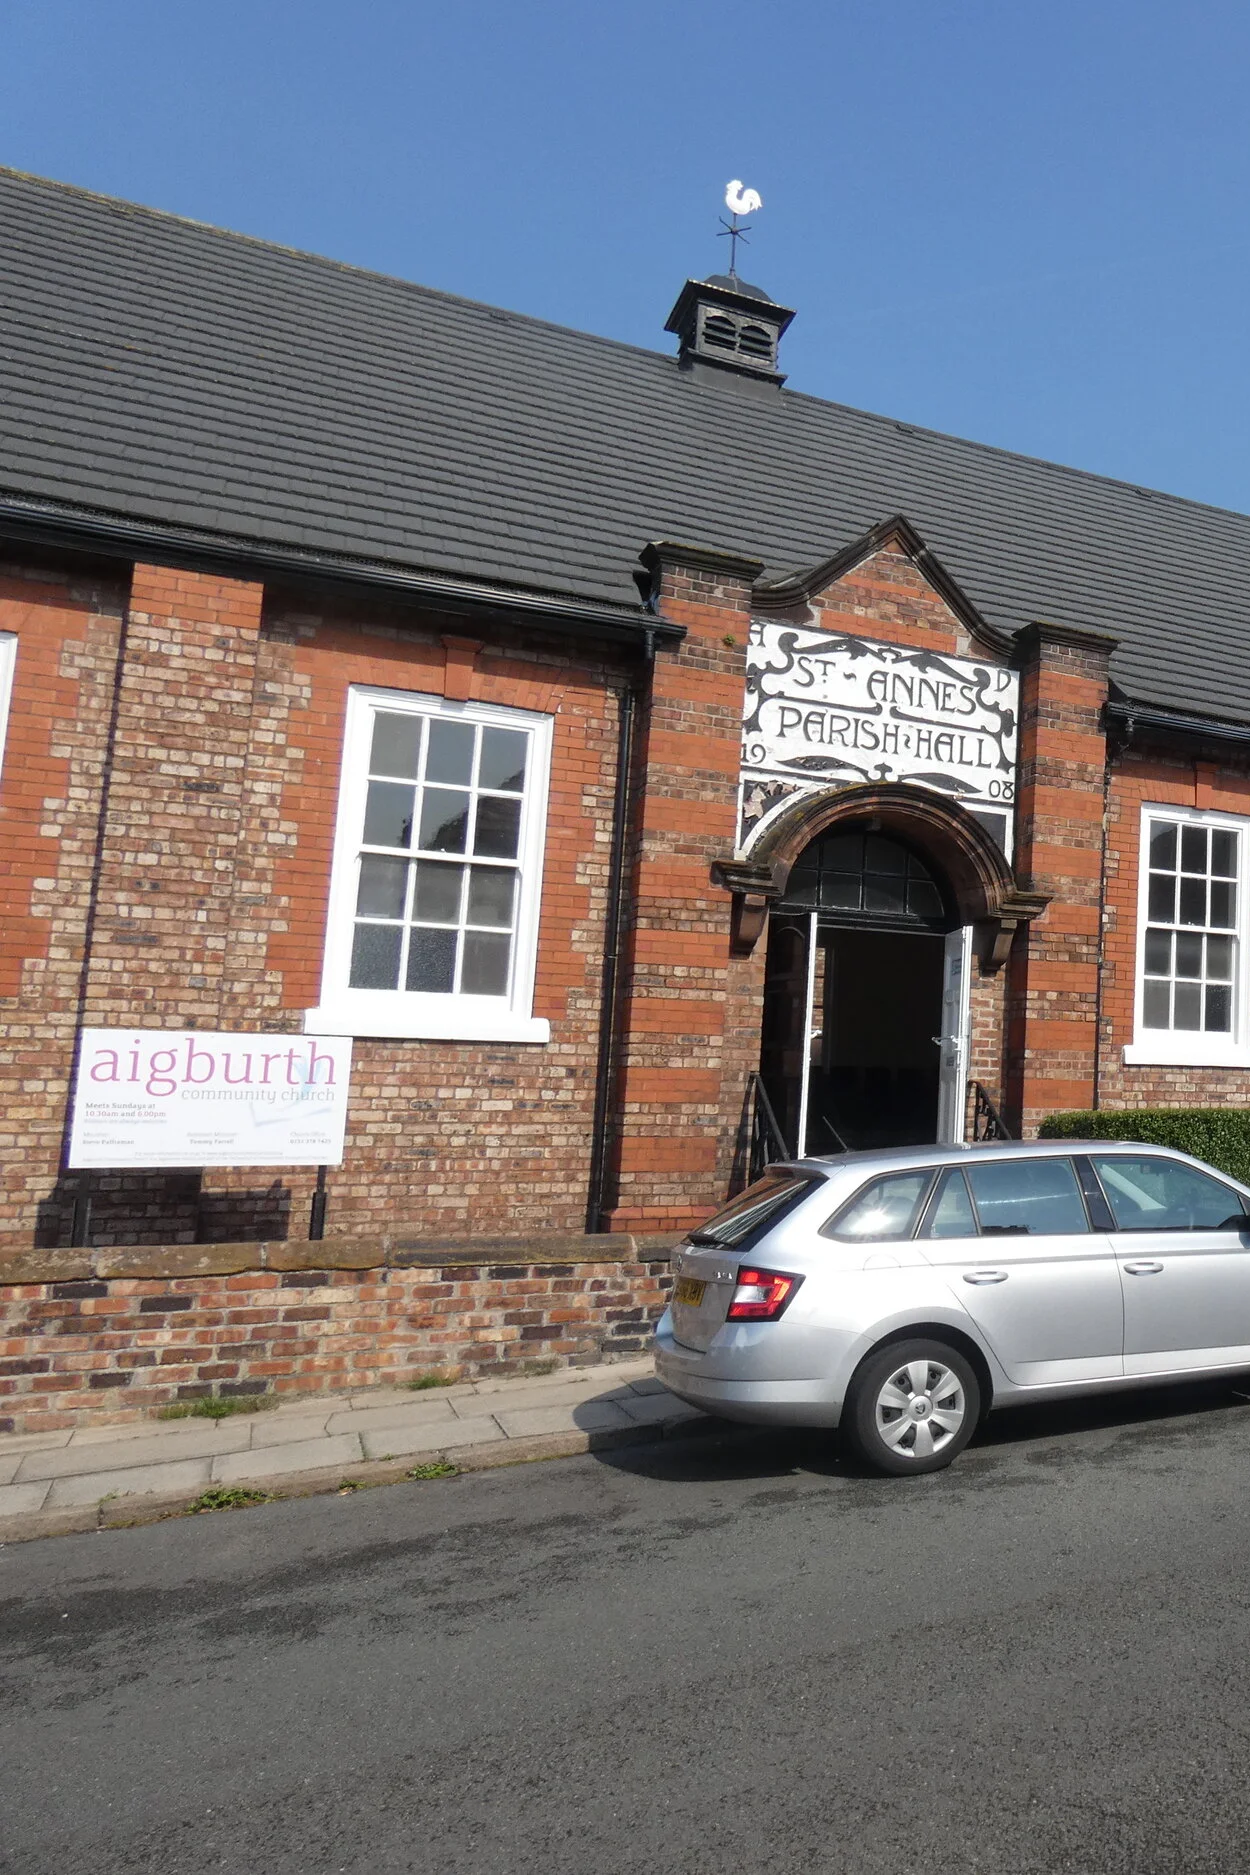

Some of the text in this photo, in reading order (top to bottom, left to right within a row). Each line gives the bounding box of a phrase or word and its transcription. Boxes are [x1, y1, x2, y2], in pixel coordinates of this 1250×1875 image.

[866, 670, 977, 716] ANNES
[777, 706, 993, 769] PARISH HALL
[741, 743, 766, 764] 19
[988, 779, 1014, 800] 08
[90, 1037, 337, 1098] aigburth
[111, 1102, 147, 1110] Sundays
[181, 1087, 335, 1104] community church
